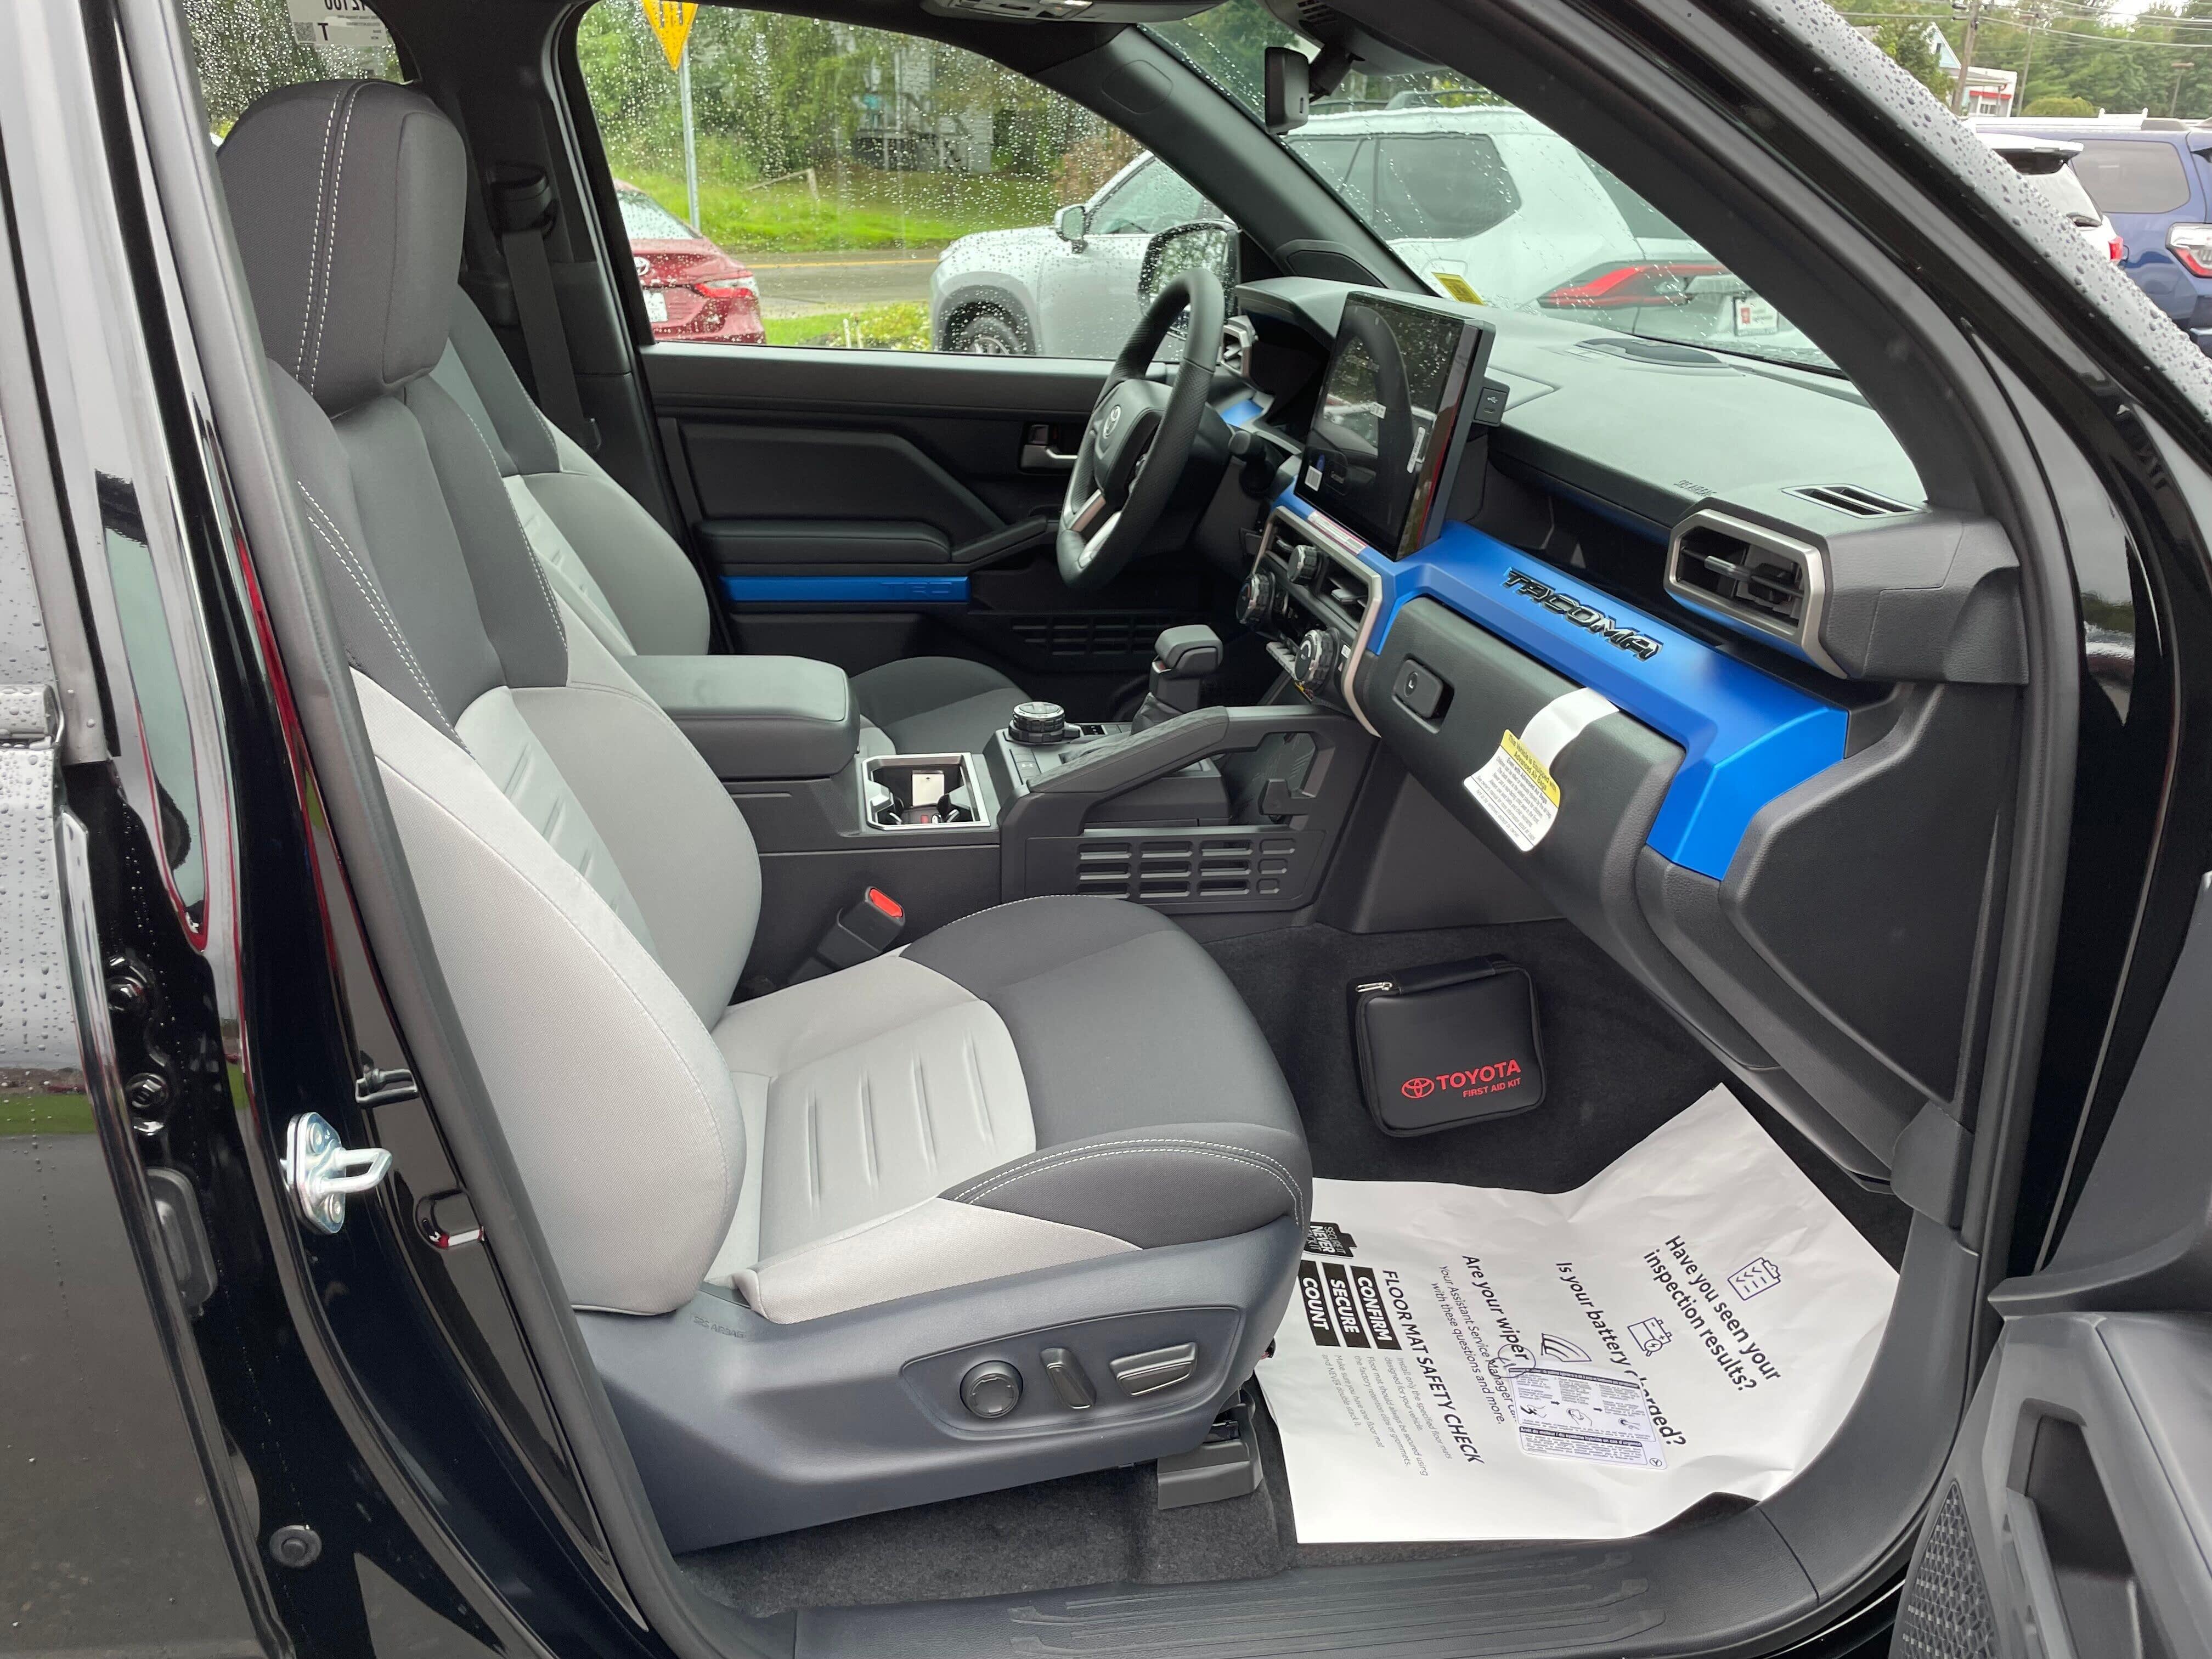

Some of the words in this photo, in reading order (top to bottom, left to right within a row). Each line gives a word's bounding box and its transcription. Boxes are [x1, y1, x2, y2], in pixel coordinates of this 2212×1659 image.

[1502, 567, 1663, 662] TACOMA
[1436, 1059, 1522, 1091] TOYOTA
[1463, 1087, 1487, 1098] FIRST
[1491, 1082, 1506, 1092] AID
[1508, 1077, 1522, 1088] KIT
[1310, 1225, 1336, 1254] NEVER
[1462, 1255, 1484, 1278] Are
[1555, 1262, 1572, 1272] Is
[1559, 1276, 1594, 1307] your
[1302, 1277, 1329, 1331] COUNT
[1330, 1279, 1360, 1334] SECURE
[1357, 1276, 1392, 1341] CONFIRM
[1471, 1281, 1504, 1314] your
[1643, 1249, 1705, 1329] inspection
[1699, 1328, 1757, 1391] results?
[1664, 1234, 1697, 1275] Have
[1688, 1273, 1719, 1302] you
[1713, 1301, 1748, 1342] seen
[1738, 1341, 1781, 1380] your
[1431, 1283, 1447, 1302] with
[1440, 1304, 1458, 1326] these
[1451, 1328, 1481, 1373] questions
[1475, 1375, 1495, 1393] and
[1485, 1396, 1505, 1424] more.
[1438, 1266, 1453, 1285] Your
[1447, 1286, 1475, 1324] Assistant
[1467, 1325, 1490, 1357] Service
[1485, 1359, 1513, 1401] Manager
[1496, 1317, 1529, 1360] wiper
[1585, 1310, 1631, 1365] battery
[1382, 1269, 1412, 1320] FLOOR
[1401, 1323, 1429, 1353] MAT
[1416, 1357, 1456, 1410] SAFETY
[1443, 1413, 1485, 1464] CHECK
